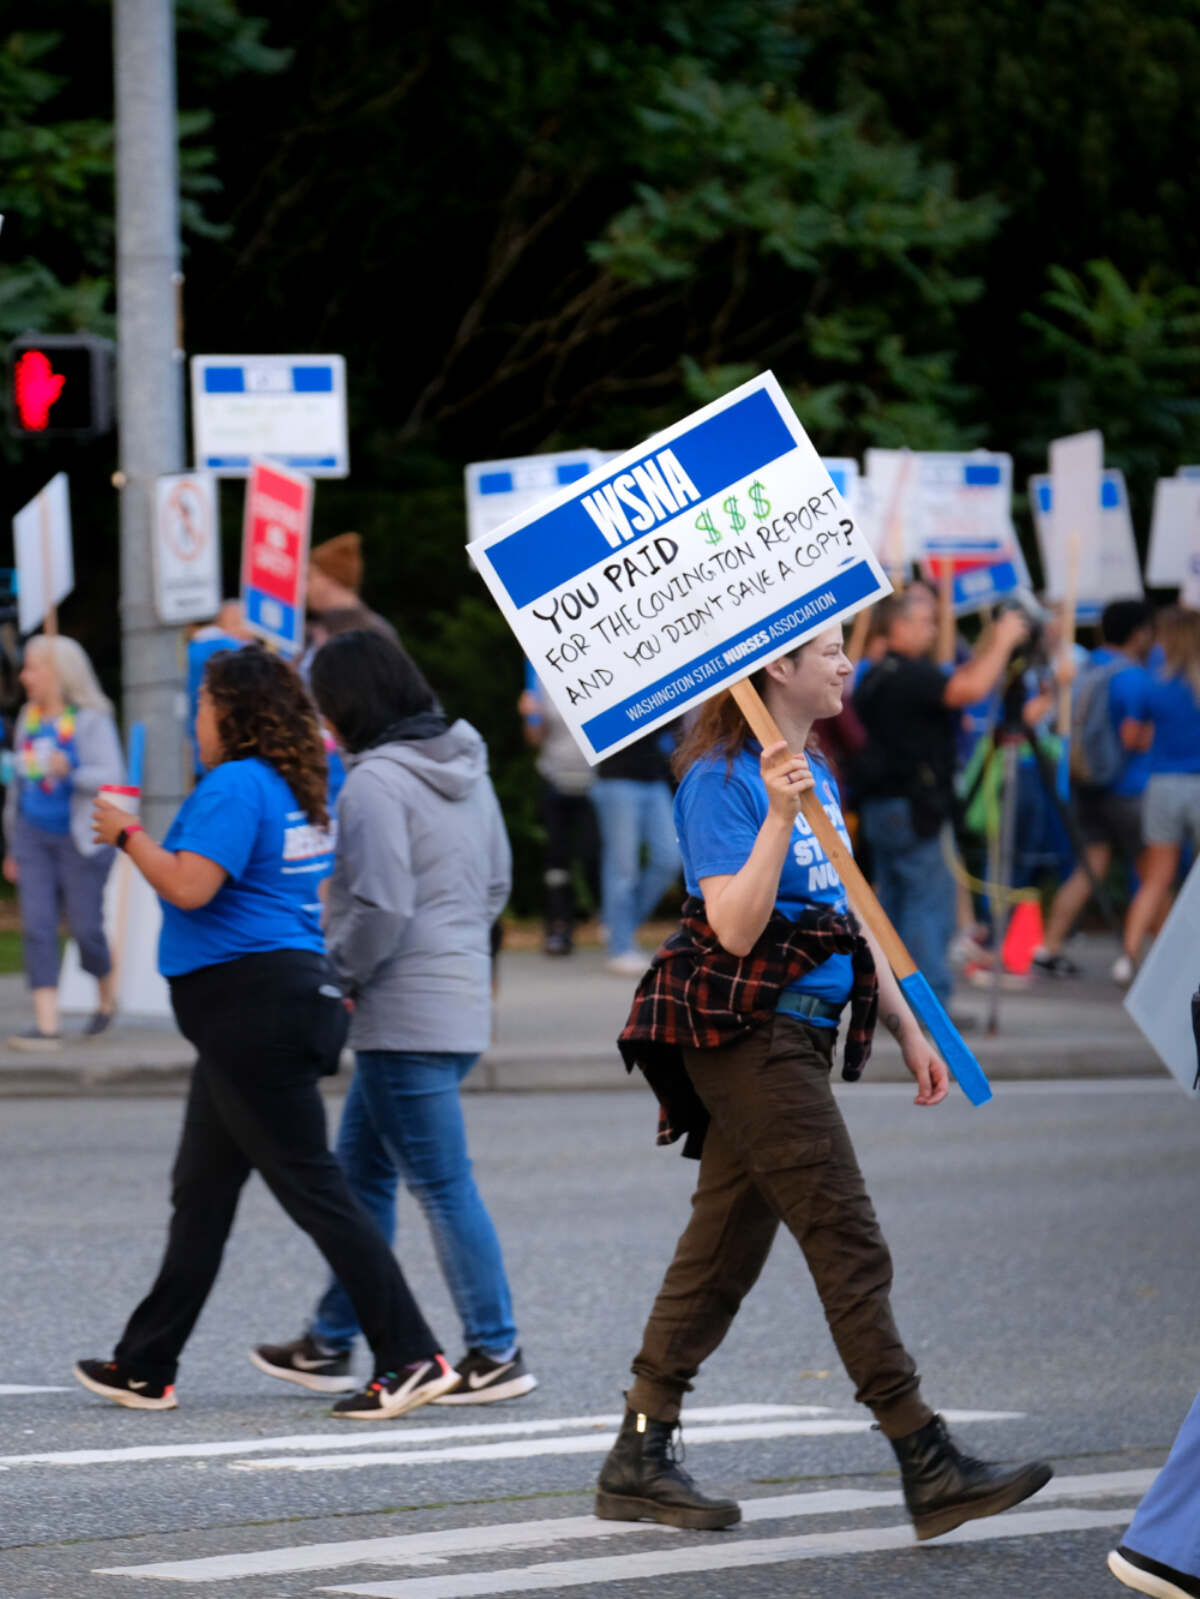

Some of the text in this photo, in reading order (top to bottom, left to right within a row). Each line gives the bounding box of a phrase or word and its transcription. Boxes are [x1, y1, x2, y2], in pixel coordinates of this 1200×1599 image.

[580, 448, 702, 549] WSNA
[532, 582, 599, 634] YOU
[603, 537, 679, 593] PAID
[545, 488, 838, 672] FOR THE COVINGTON REPORT
[565, 668, 614, 706] AND
[623, 635, 661, 666] YOU
[726, 569, 775, 606] SAVE
[777, 560, 797, 581] A
[795, 519, 854, 567] COPY?
[625, 591, 838, 722] WASHINGTON STATE NURSES ASSOCIATION
